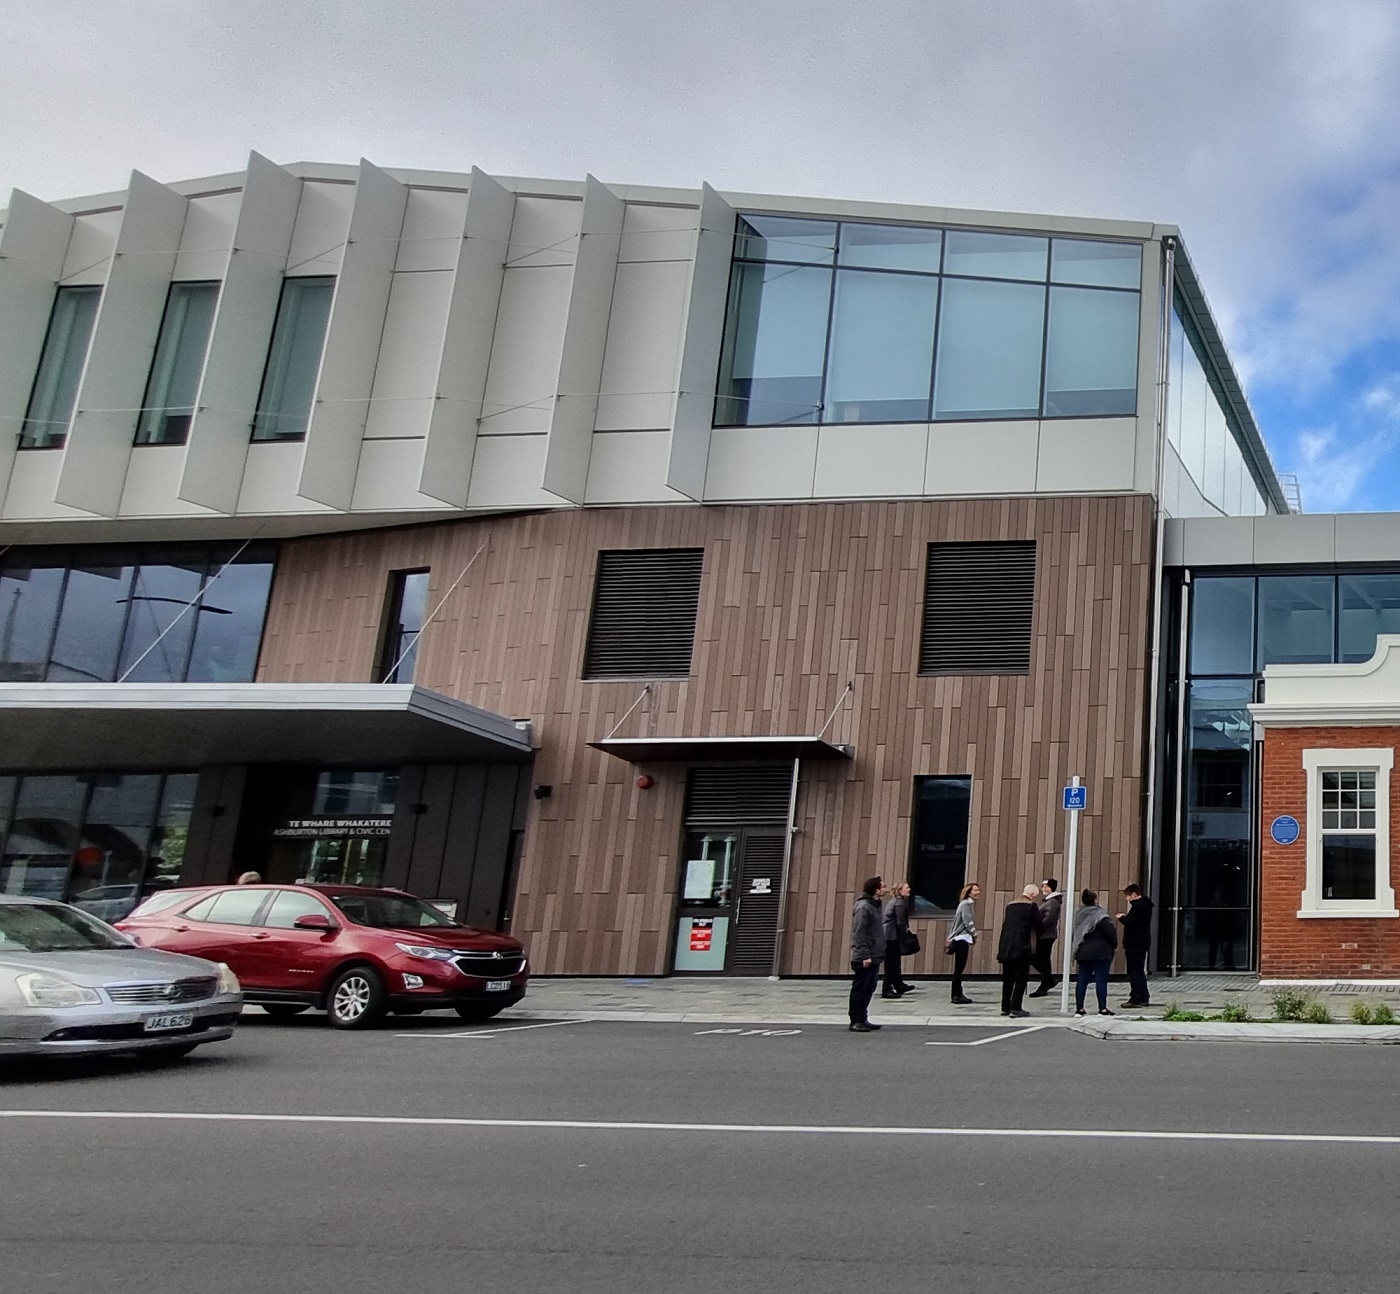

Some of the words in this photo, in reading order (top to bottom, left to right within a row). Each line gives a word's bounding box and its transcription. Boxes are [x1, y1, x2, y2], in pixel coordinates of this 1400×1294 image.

[1071, 789, 1079, 797] P
[1069, 796, 1080, 804] 120
[273, 828, 318, 836] ASHBURTON
[694, 1028, 803, 1036] P10
